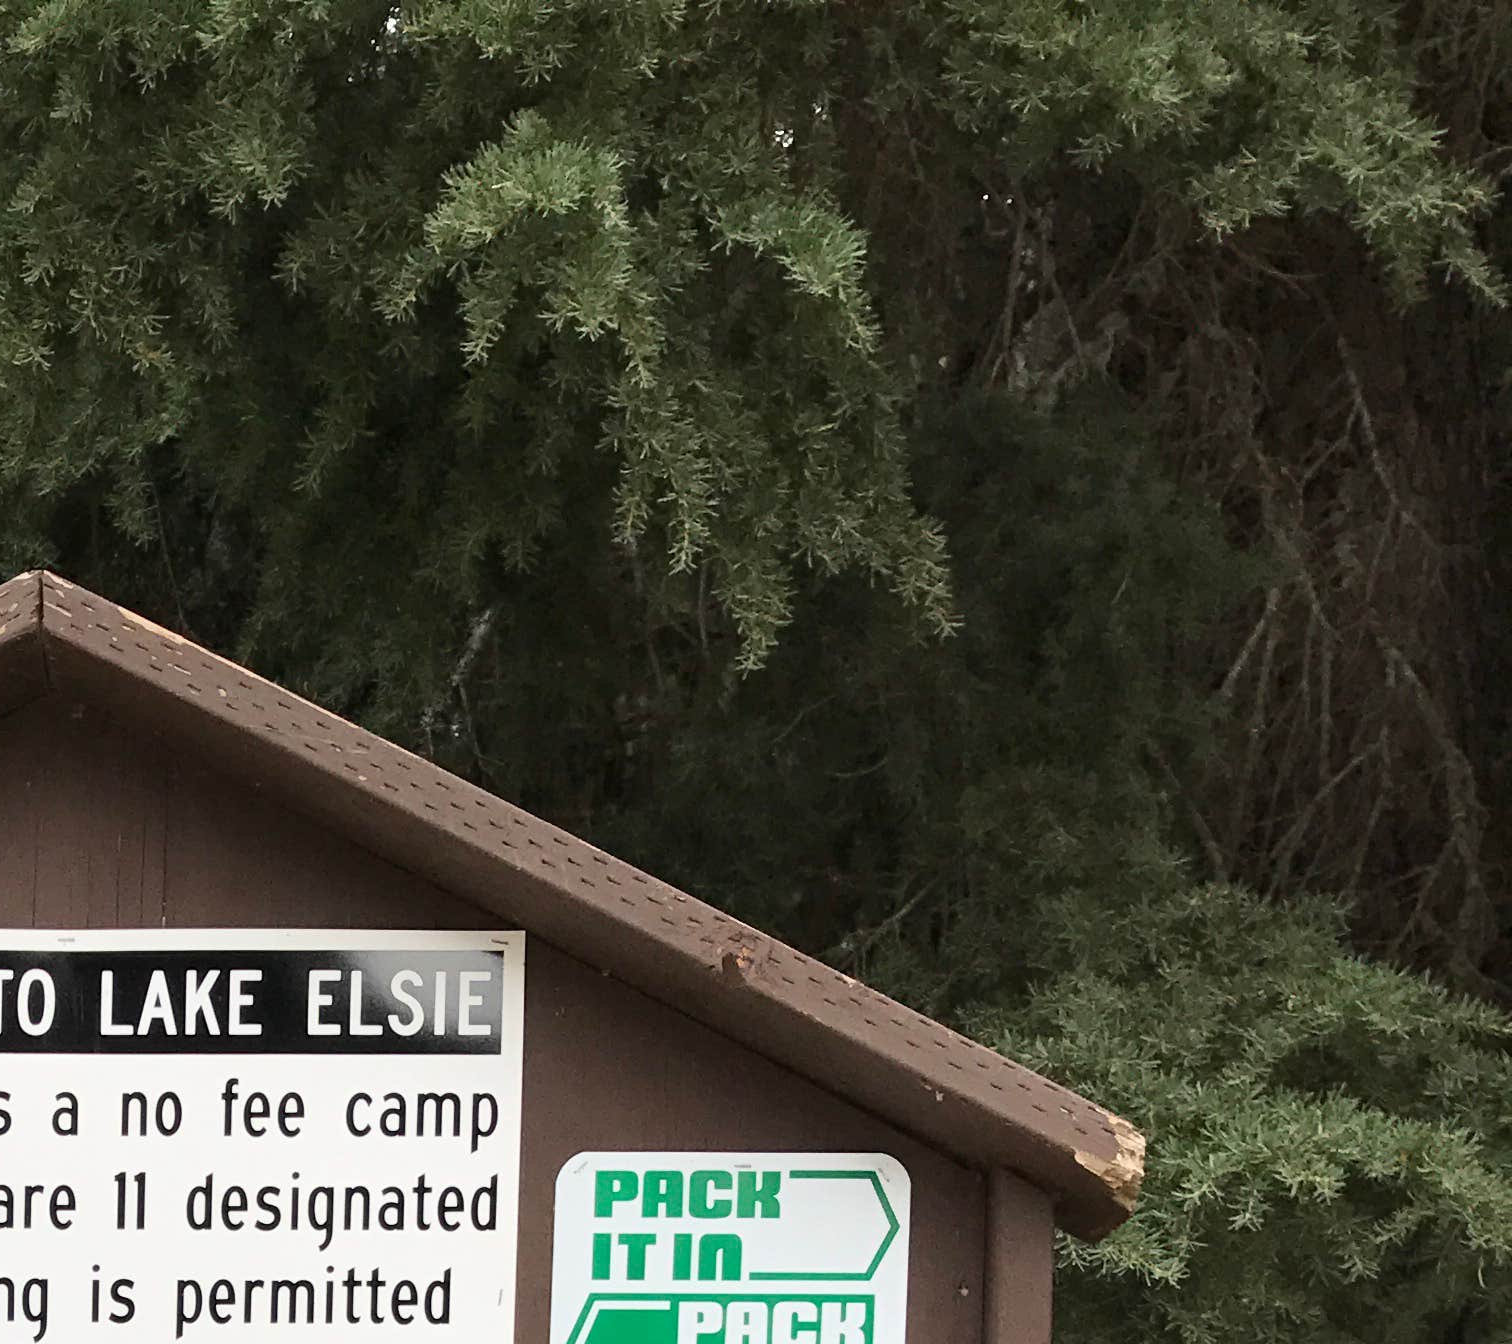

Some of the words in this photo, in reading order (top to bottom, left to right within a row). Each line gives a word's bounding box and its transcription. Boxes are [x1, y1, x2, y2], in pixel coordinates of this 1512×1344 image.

[101, 970, 262, 1035] LAKE
[307, 969, 493, 1038] ELSIE
[52, 1092, 78, 1136] a
[122, 1092, 182, 1136] no
[222, 1078, 304, 1137] fee
[346, 1093, 498, 1152] camp
[115, 1172, 145, 1229] 11
[187, 1172, 497, 1251] designated
[595, 1171, 781, 1218] PACK
[592, 1233, 656, 1280] IT
[92, 1265, 135, 1323] is
[176, 1266, 451, 1338] permitted
